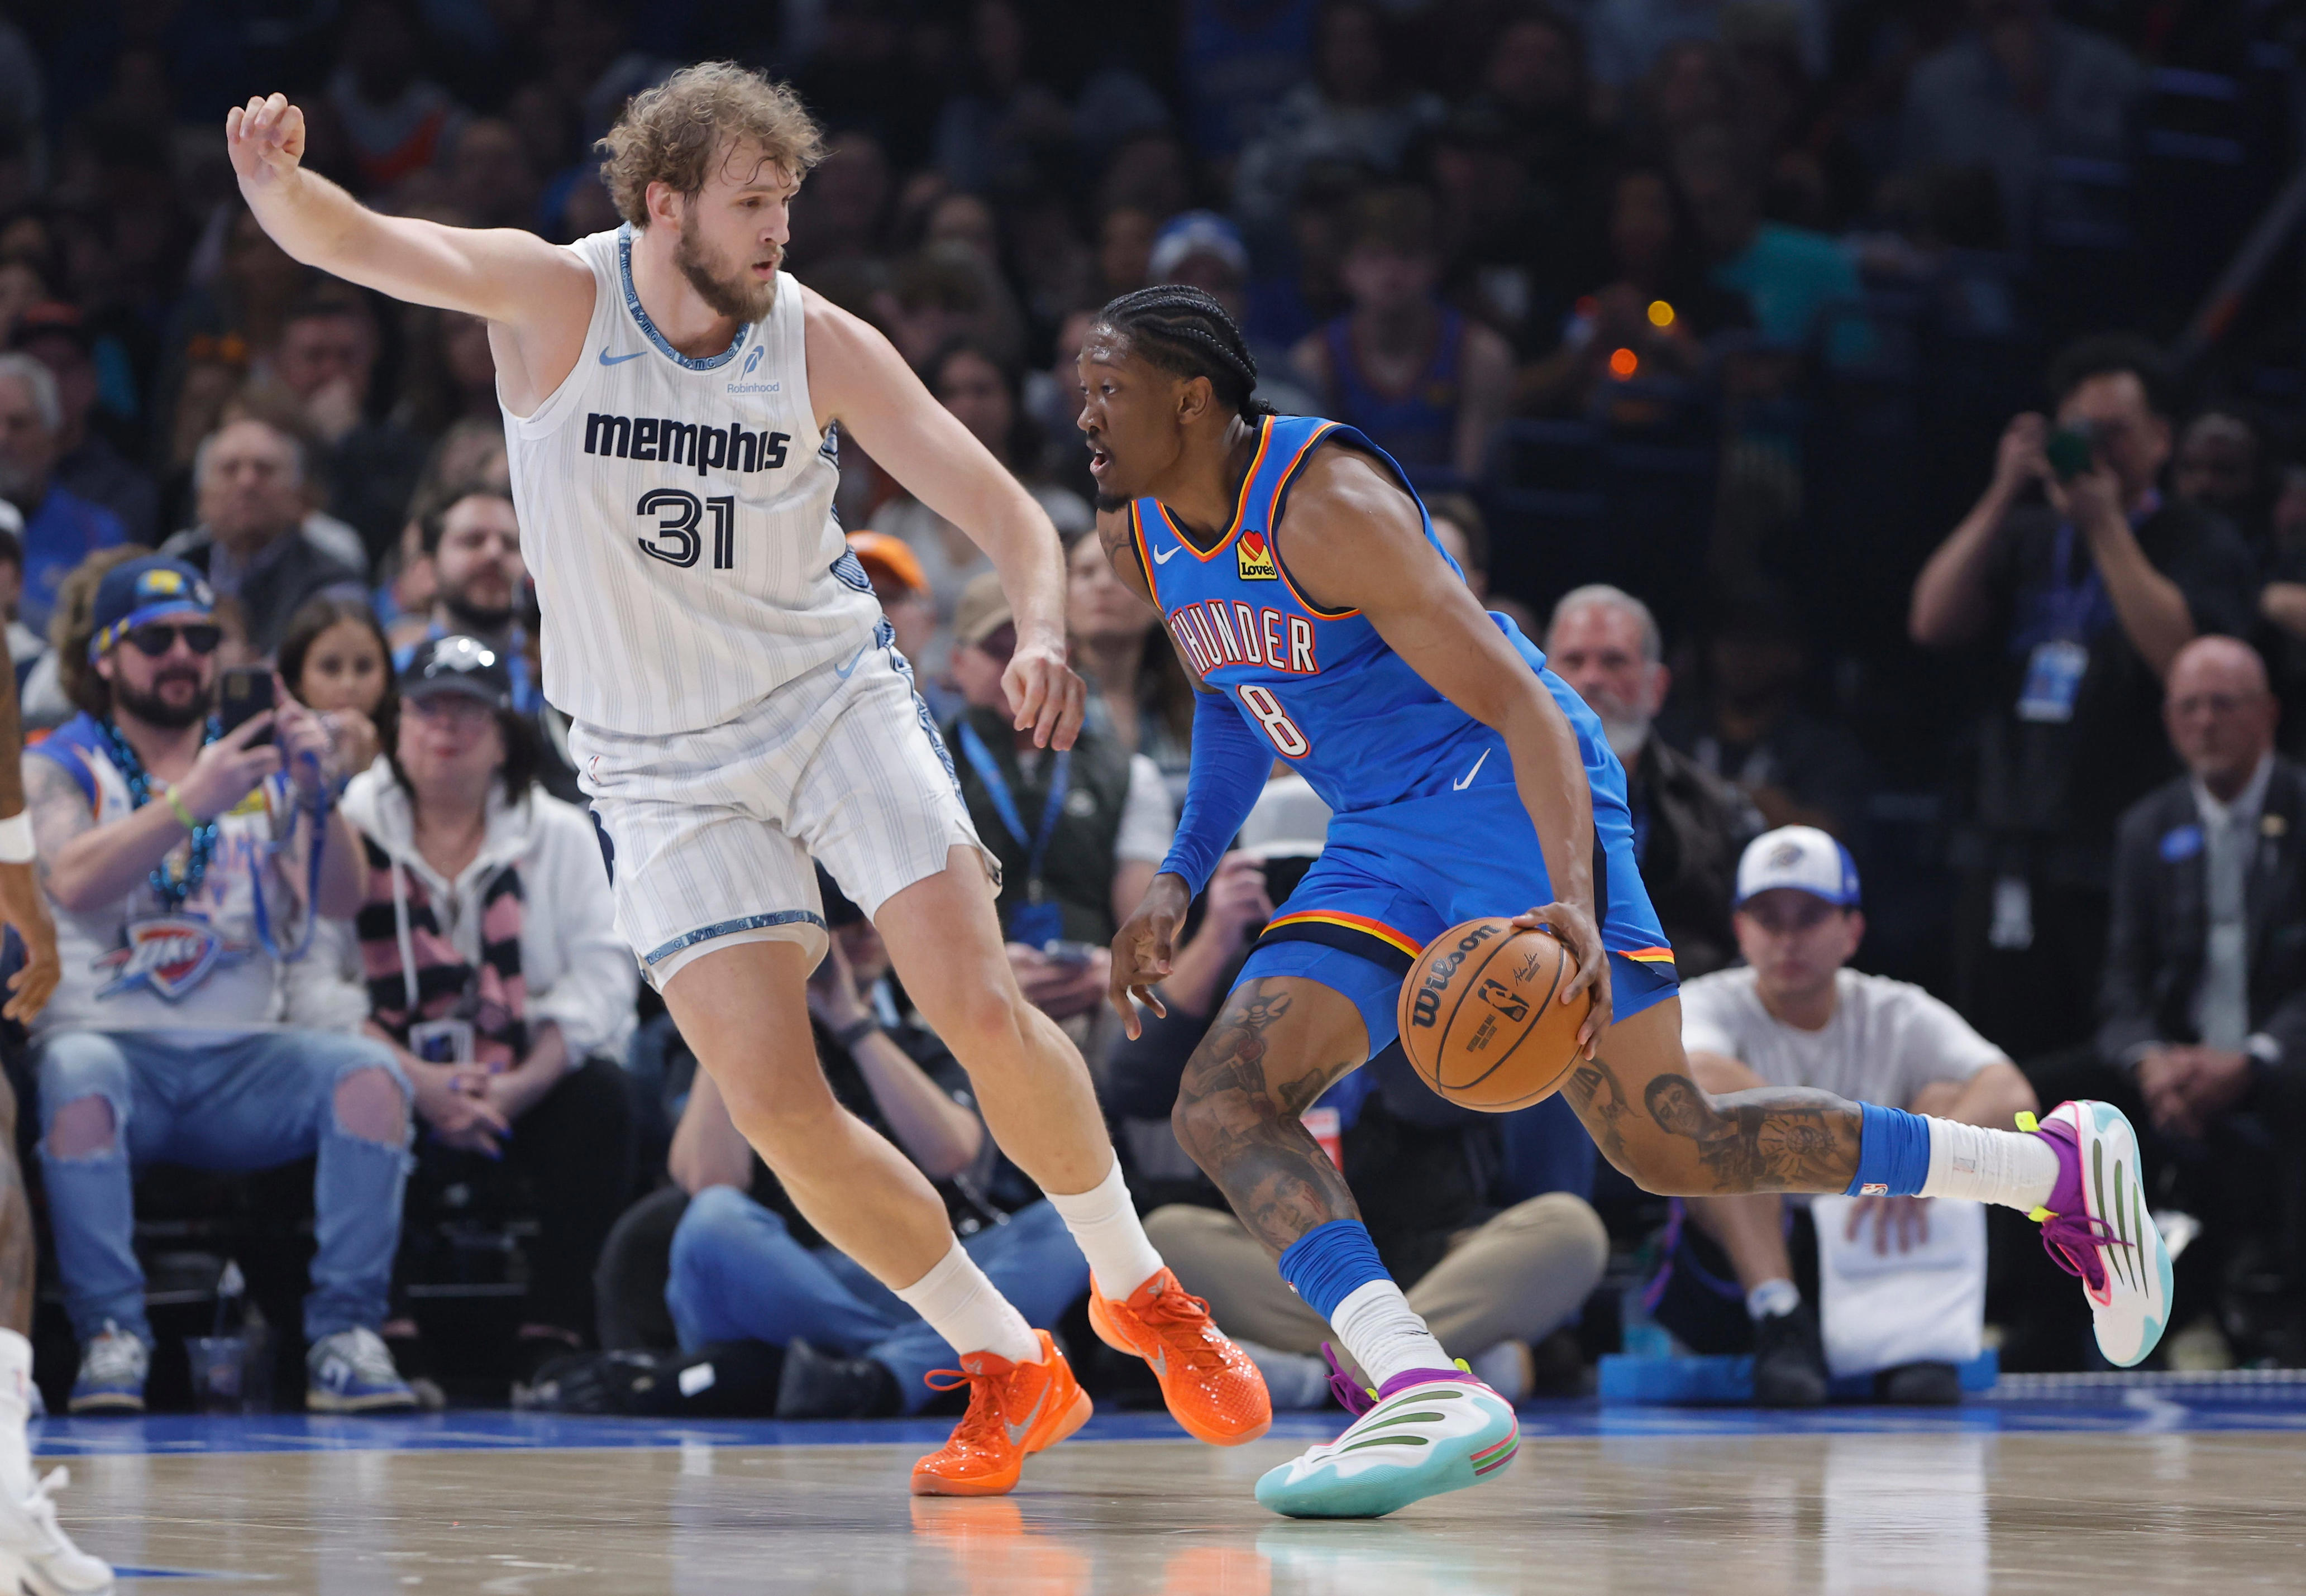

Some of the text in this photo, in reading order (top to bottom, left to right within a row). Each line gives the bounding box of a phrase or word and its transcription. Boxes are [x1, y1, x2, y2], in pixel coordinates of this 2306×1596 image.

[727, 381, 780, 393] Robinhood
[584, 413, 791, 476] memphis
[637, 488, 734, 568] 31
[1236, 684, 1311, 759] 8
[1412, 925, 1502, 1028] Wilson
